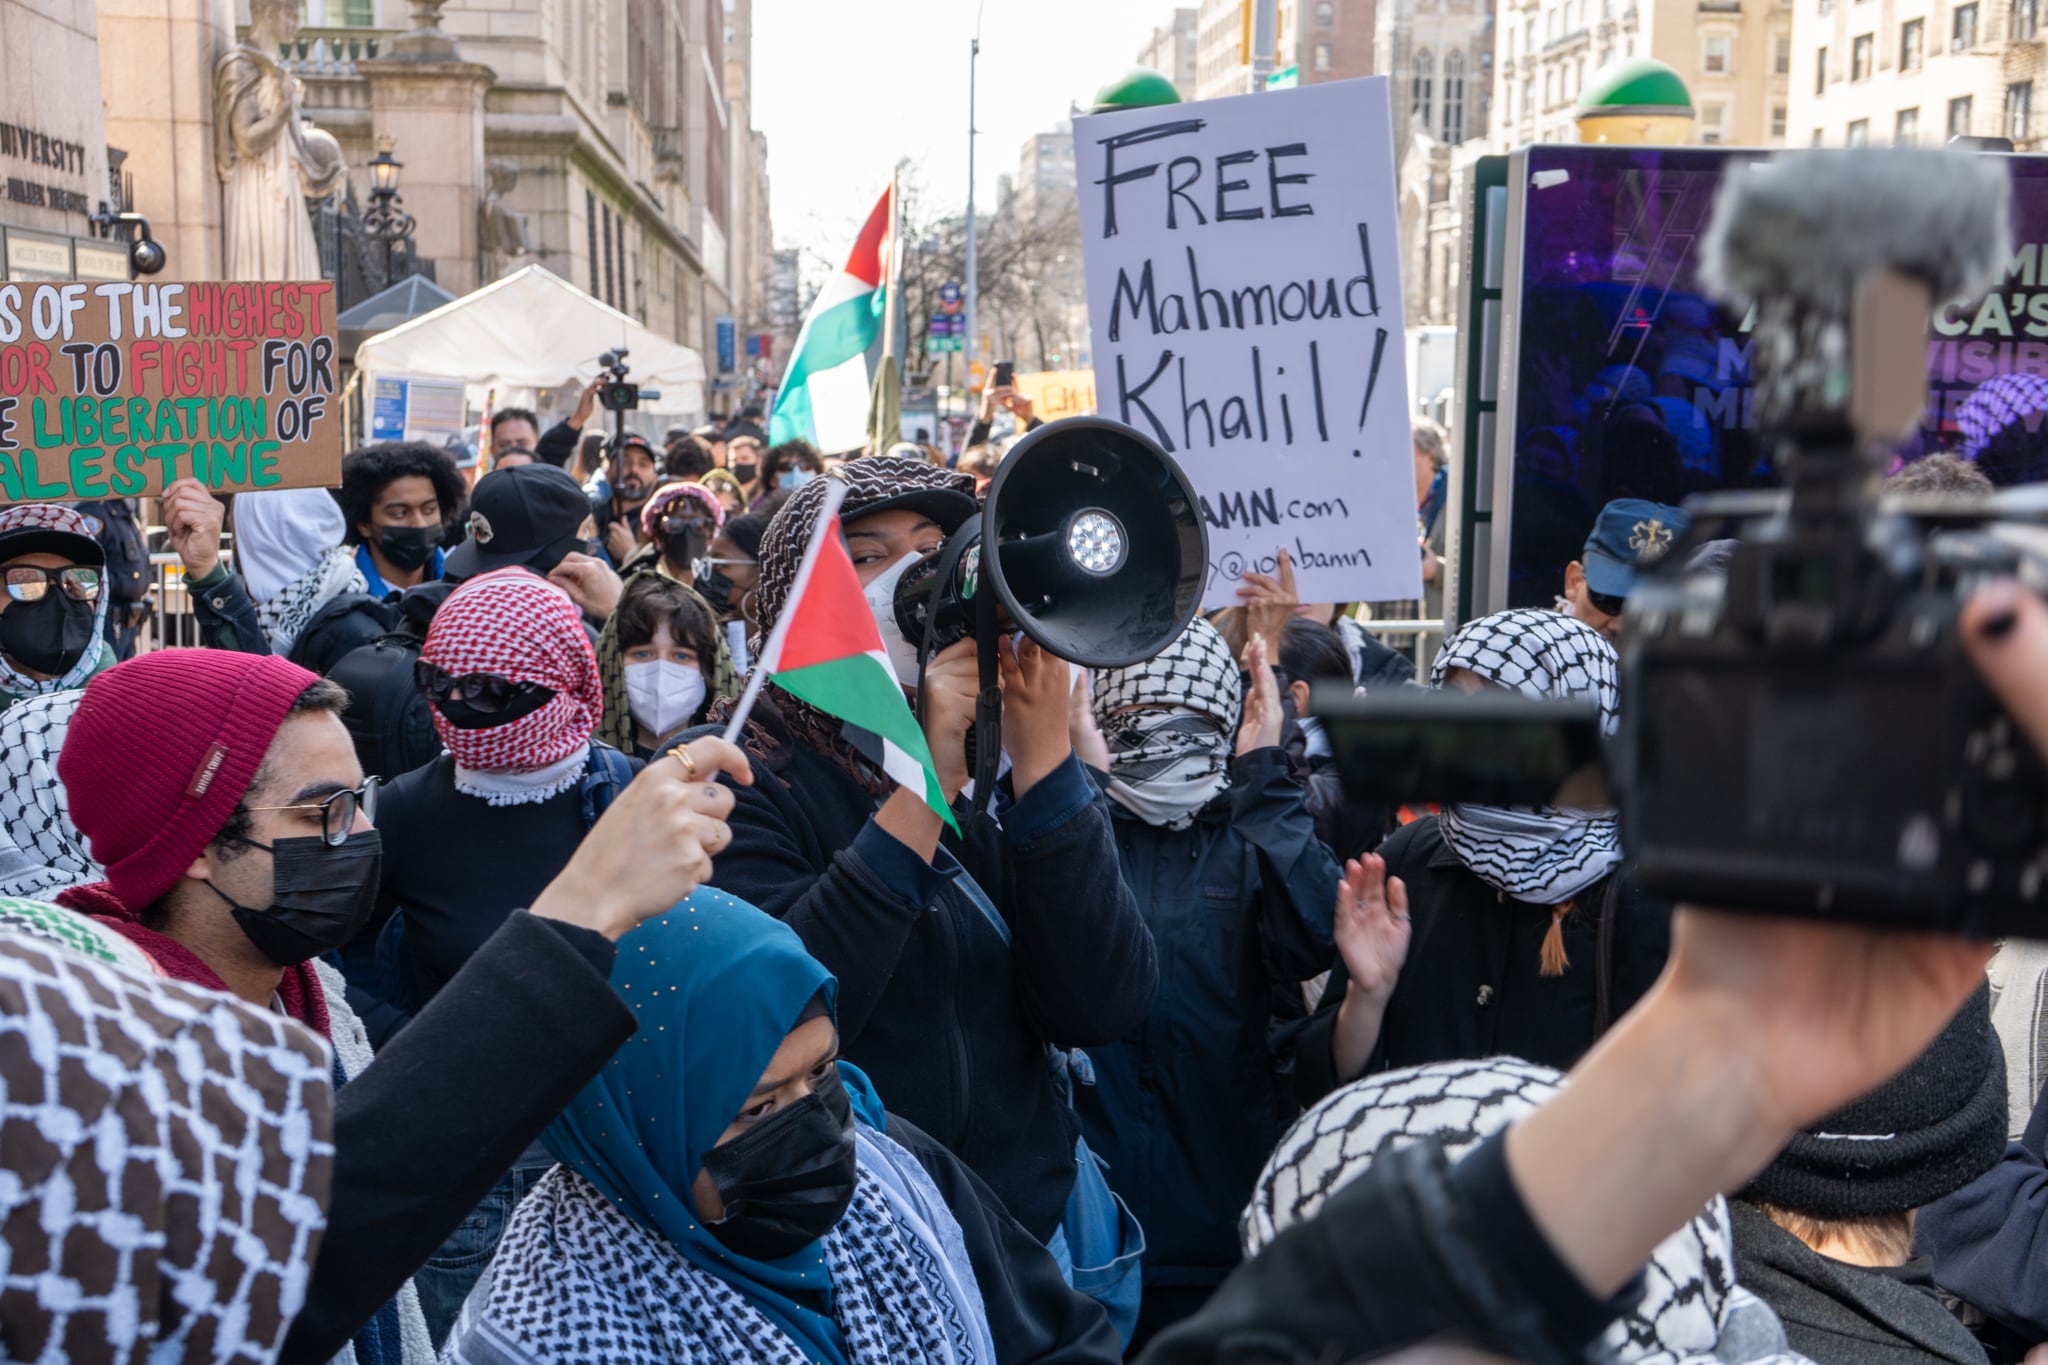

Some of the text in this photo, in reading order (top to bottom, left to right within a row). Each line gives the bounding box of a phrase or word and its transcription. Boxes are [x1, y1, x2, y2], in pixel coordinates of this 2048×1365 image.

[0, 122, 85, 176] NIVERSITY
[1094, 118, 1316, 239] FREE
[31, 284, 88, 341] OF
[95, 283, 187, 340] THE
[188, 283, 333, 337] HIGHEST
[1108, 223, 1380, 342] Mahmoud
[1926, 292, 2048, 337] CA'S
[1, 336, 335, 397] OR TO FIGHT FOR
[1116, 328, 1388, 457] Khalil!
[32, 395, 266, 448] LIBERATION
[275, 396, 327, 443] OF
[0, 441, 282, 500] ALESTINE
